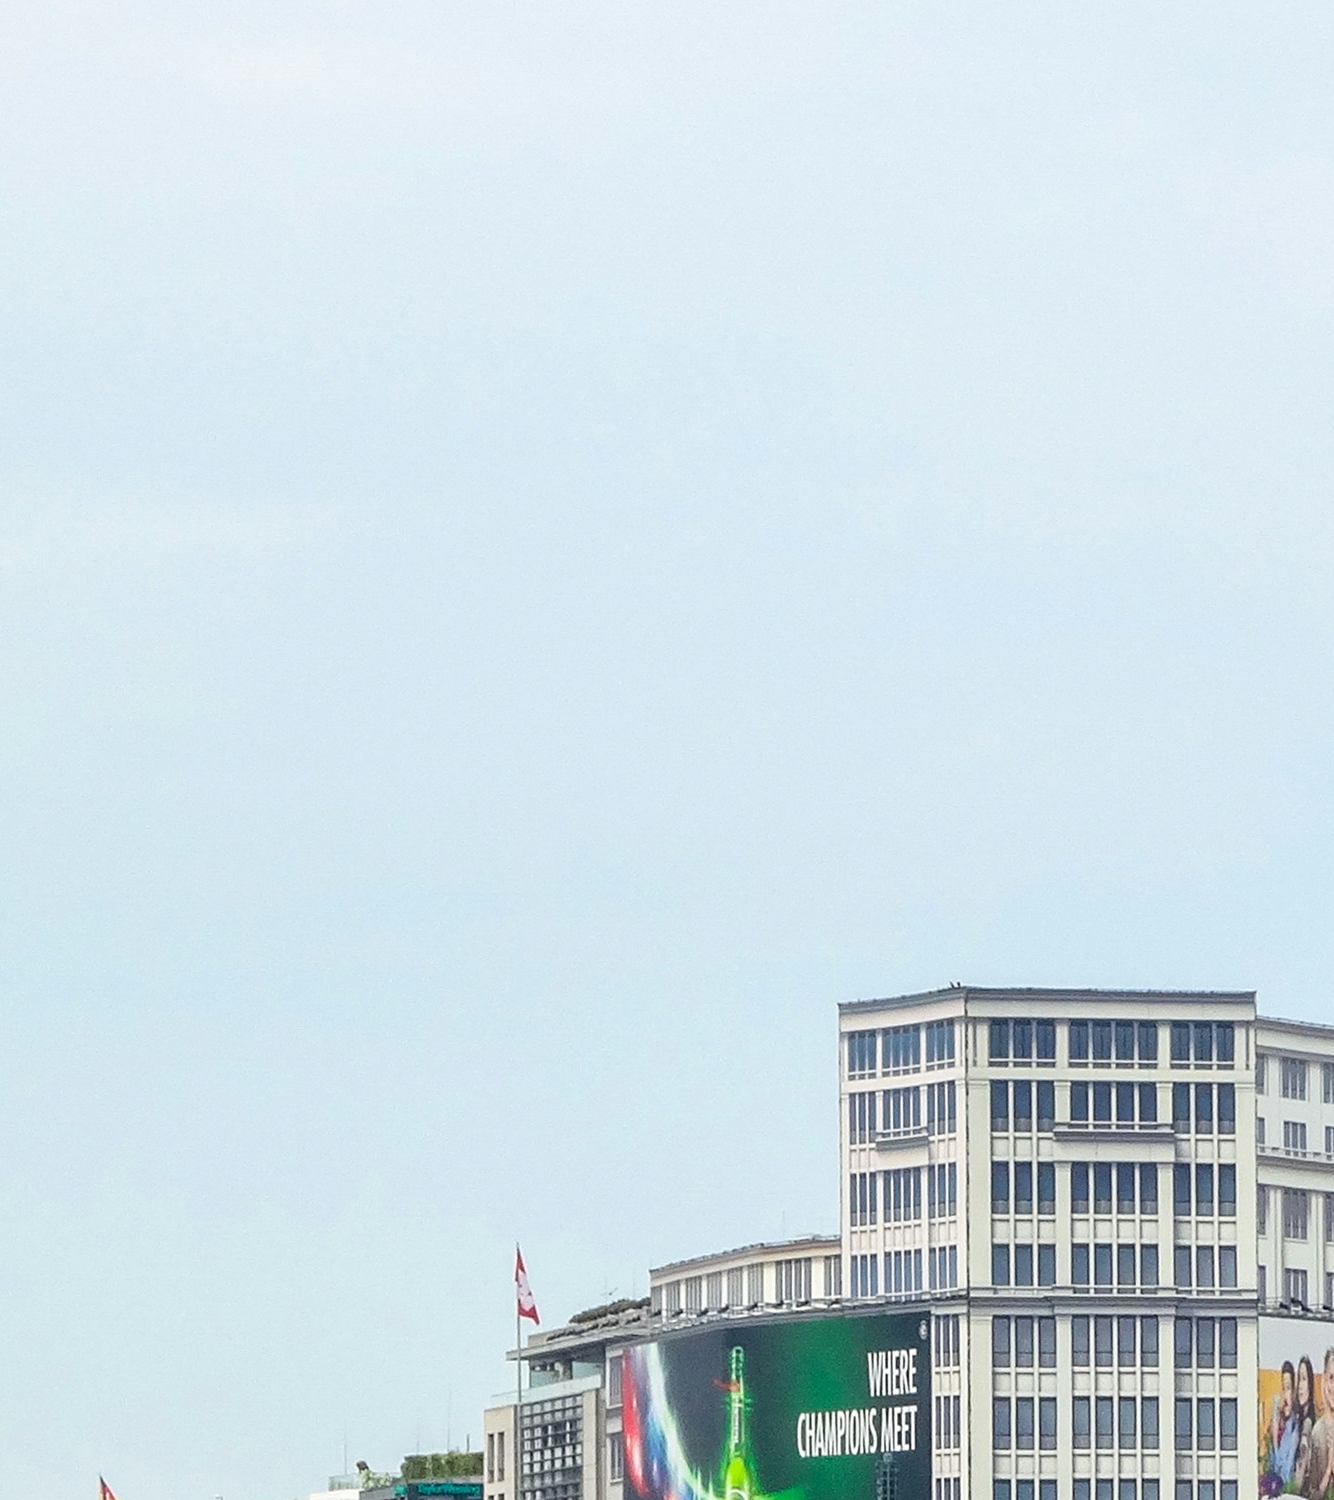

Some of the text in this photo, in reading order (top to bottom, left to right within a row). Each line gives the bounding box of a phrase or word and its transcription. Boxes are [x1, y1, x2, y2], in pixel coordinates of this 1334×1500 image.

[867, 1348, 917, 1397] WHERE
[797, 1407, 878, 1458] CHAMPIONS
[880, 1405, 918, 1453] MEET
